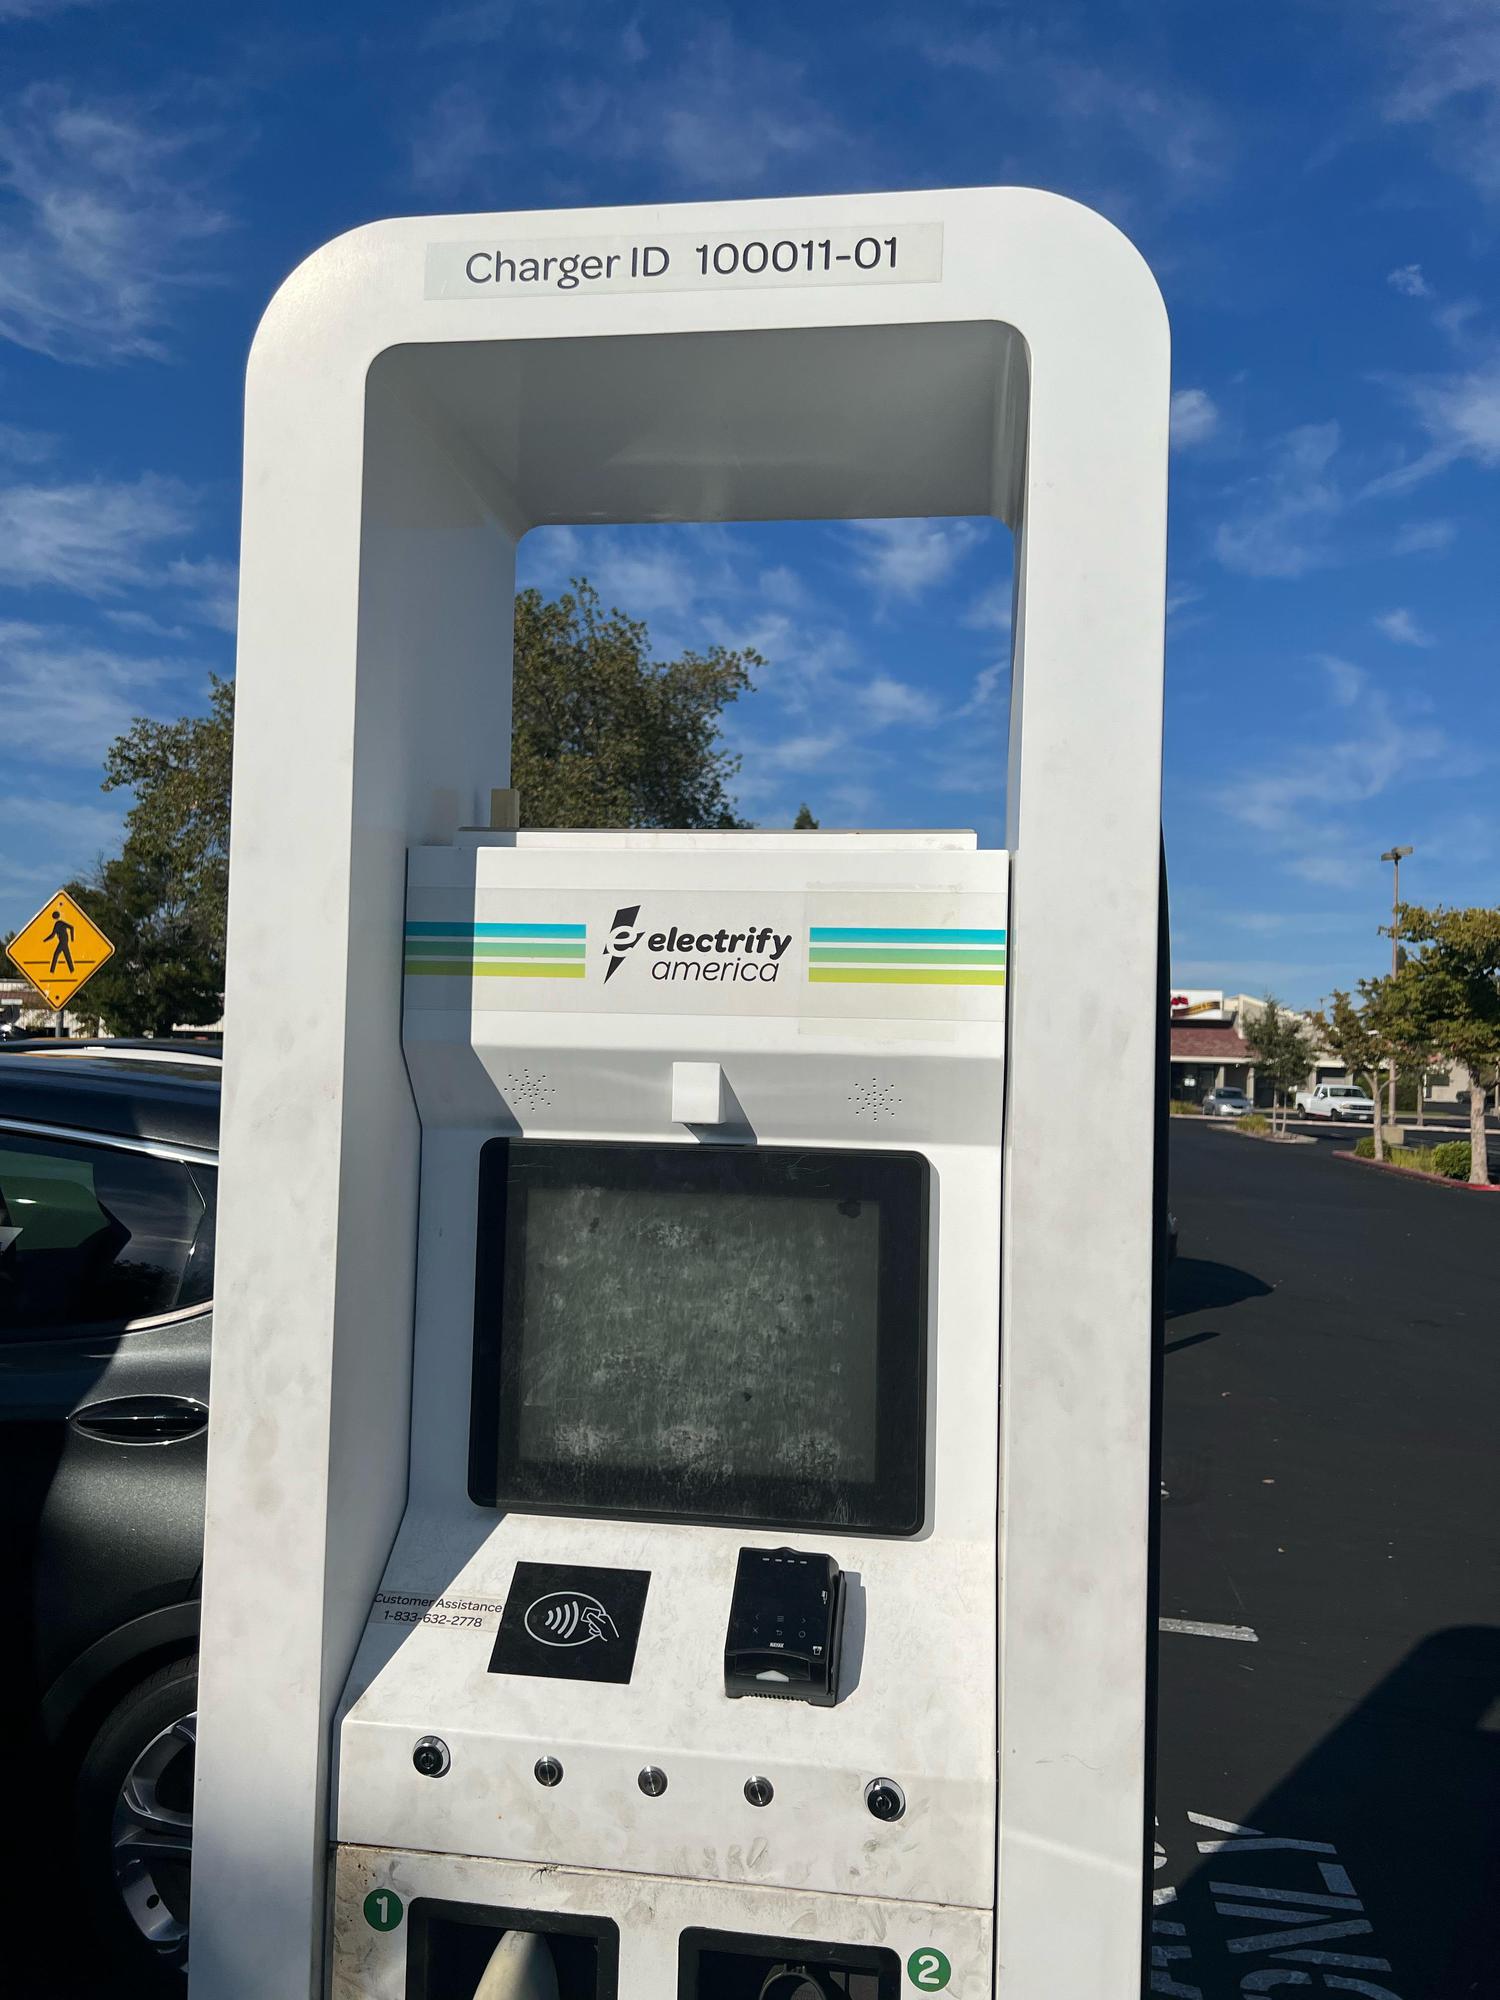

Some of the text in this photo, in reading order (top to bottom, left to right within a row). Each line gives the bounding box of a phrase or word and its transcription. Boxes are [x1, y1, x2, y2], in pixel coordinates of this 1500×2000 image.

[465, 236, 899, 290] Charger ID 100011-01
[647, 926, 793, 960] electrify
[651, 957, 780, 982] america
[375, 1593, 503, 1613] Customer Assistance
[384, 1610, 483, 1627] 1-833-632-2778
[376, 1896, 388, 1924] 1
[918, 1954, 940, 1985] 2
